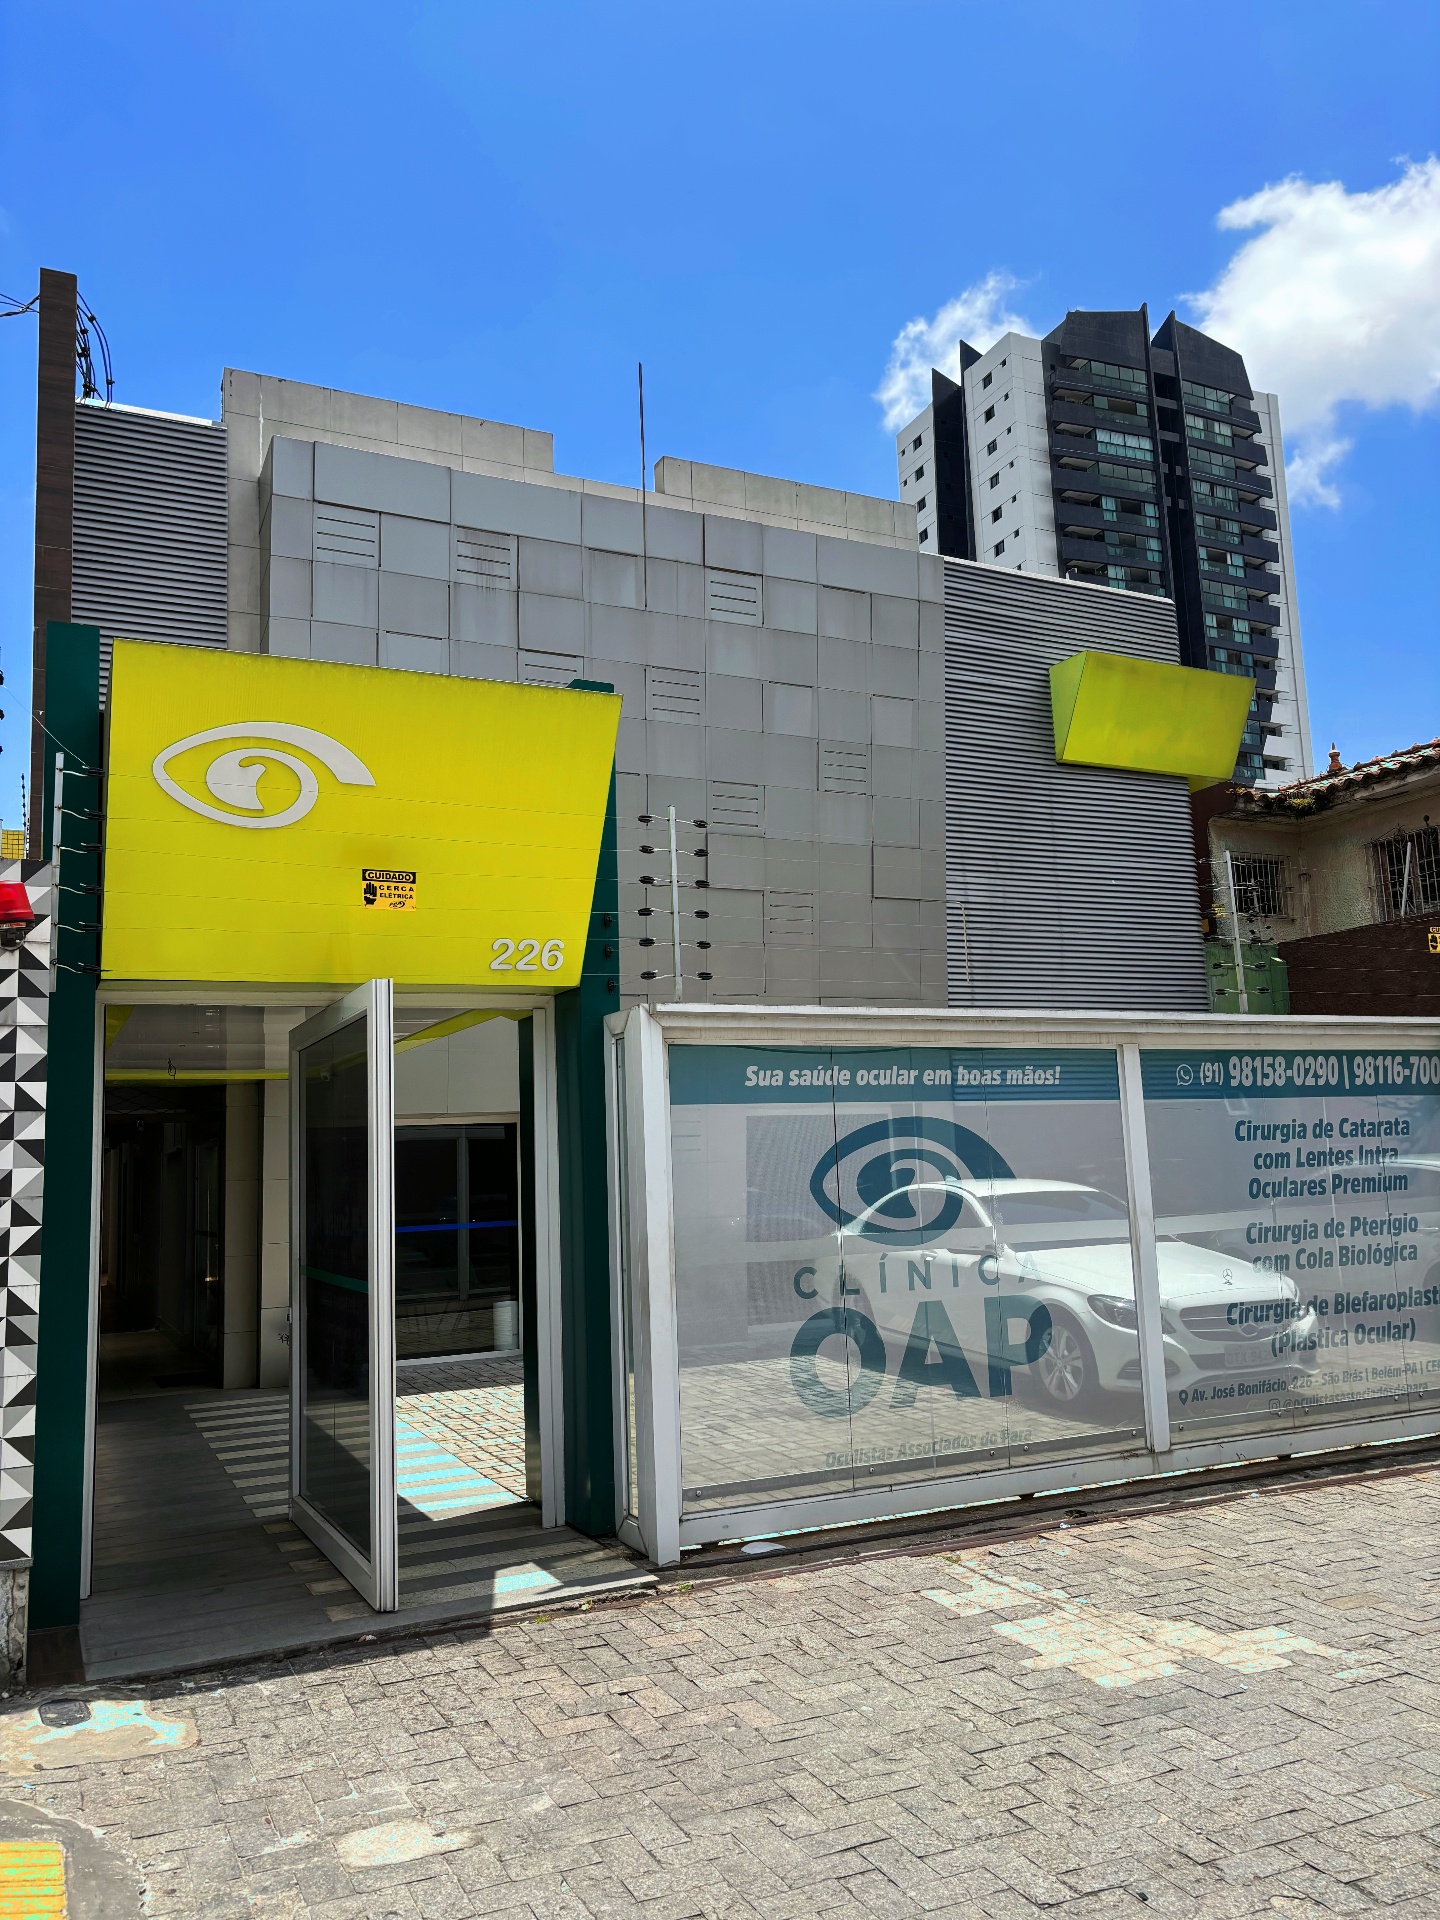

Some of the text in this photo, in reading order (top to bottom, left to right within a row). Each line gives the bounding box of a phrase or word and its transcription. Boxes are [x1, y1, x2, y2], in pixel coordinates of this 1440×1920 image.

[367, 872, 411, 882] CUIDADO
[489, 938, 565, 971] 226
[745, 1065, 1061, 1087] Sua saúde ocular em boas mãos!
[1200, 1062, 1223, 1086] (91)
[1229, 1055, 1339, 1087] 98158-0290
[1235, 1117, 1411, 1143] Cirurgia de Catarata
[1254, 1145, 1399, 1170] com Lentes Intra
[1248, 1172, 1409, 1199] Oculares Premium
[1246, 1213, 1419, 1244] Cirurgia de Pterígio
[1252, 1241, 1418, 1273] com Cola Biológica
[793, 1252, 1042, 1300] CLÍNICA
[1226, 1299, 1301, 1326] Cirurgia
[1306, 1295, 1329, 1316] de
[1354, 1317, 1416, 1346] Ocular)
[789, 1294, 1053, 1418] OAP
[1191, 1388, 1208, 1402] Av.
[1211, 1384, 1235, 1400] José
[1237, 1378, 1290, 1397] Bonifácio,
[1292, 1375, 1313, 1389] 226
[1321, 1371, 1340, 1386] São
[1342, 1368, 1364, 1384] Brás
[1371, 1361, 1418, 1380] Belém-PA
[825, 1447, 894, 1468] Oculistas
[898, 1434, 977, 1457] Associados
[980, 1431, 998, 1447] do
